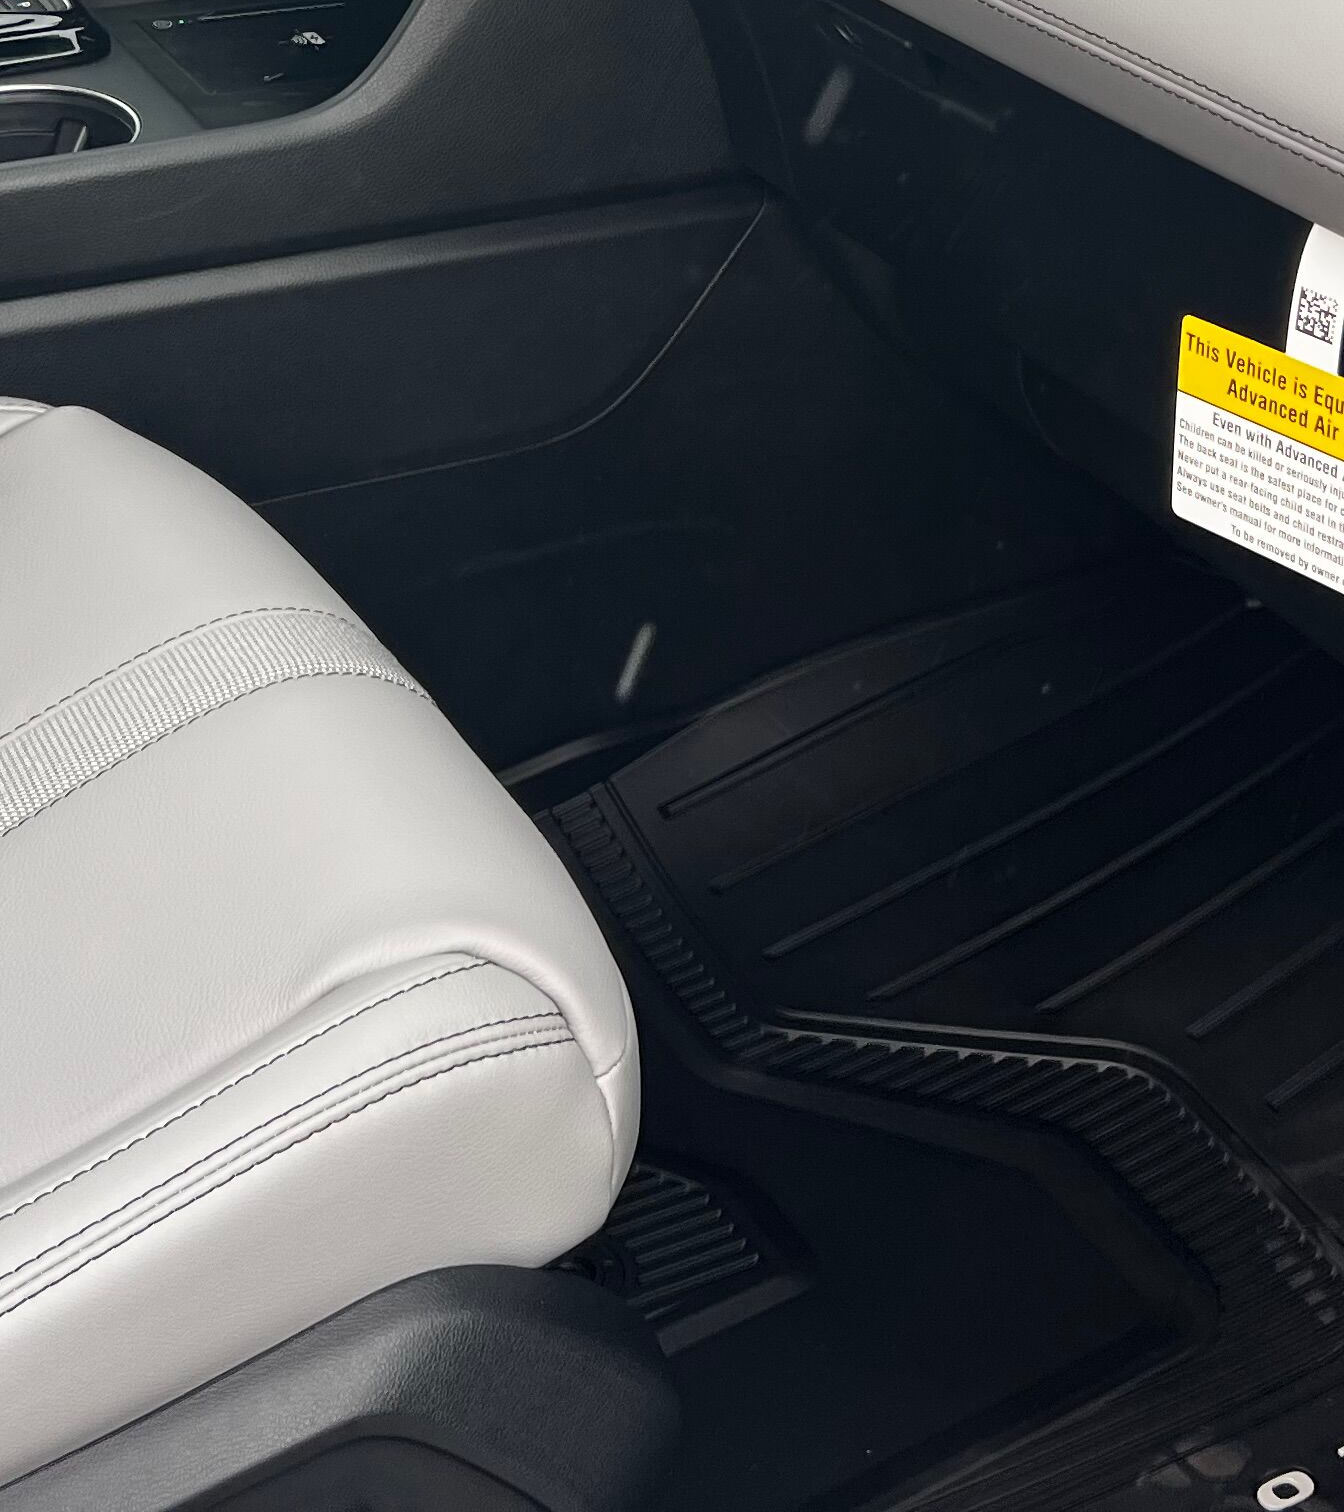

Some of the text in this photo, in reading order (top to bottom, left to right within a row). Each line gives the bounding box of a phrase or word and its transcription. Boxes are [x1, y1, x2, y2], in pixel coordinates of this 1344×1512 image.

[1186, 331, 1220, 363] This
[1226, 348, 1287, 391] Vehicle
[1293, 376, 1308, 399] is
[1226, 378, 1309, 429] Advanced
[1313, 415, 1340, 441] Air
[1178, 433, 1195, 450] The
[1196, 441, 1217, 460] back
[1219, 453, 1239, 469] seat
[1240, 462, 1249, 474] is
[1250, 465, 1265, 481] the
[1267, 475, 1295, 495] safest
[1297, 488, 1322, 507] place
[1324, 498, 1338, 513] for
[1179, 417, 1215, 442] Children
[1216, 436, 1233, 450] can
[1234, 442, 1246, 456] be
[1247, 448, 1273, 468] killed
[1274, 461, 1285, 472] or
[1286, 466, 1328, 494] seriously
[1212, 411, 1242, 437] Even
[1245, 428, 1272, 450] with
[1275, 439, 1338, 479] Advanced
[1176, 465, 1208, 488] Always
[1209, 482, 1226, 496] use
[1227, 490, 1247, 505] seat
[1248, 497, 1271, 517] belts
[1273, 510, 1290, 525] and
[1292, 519, 1315, 537] child
[1176, 480, 1193, 497] See
[1229, 506, 1262, 529] manual
[1263, 520, 1277, 535] for
[1278, 529, 1301, 547] more
[1177, 449, 1204, 469] Never
[1205, 463, 1220, 477] put
[1221, 470, 1227, 481] a
[1280, 497, 1303, 515] child
[1305, 508, 1325, 525] seat
[1327, 516, 1337, 530] in
[1231, 524, 1241, 538] To
[1243, 530, 1255, 544] be
[1256, 538, 1296, 564] removed
[1298, 556, 1309, 571] by
[1311, 564, 1340, 584] owner
